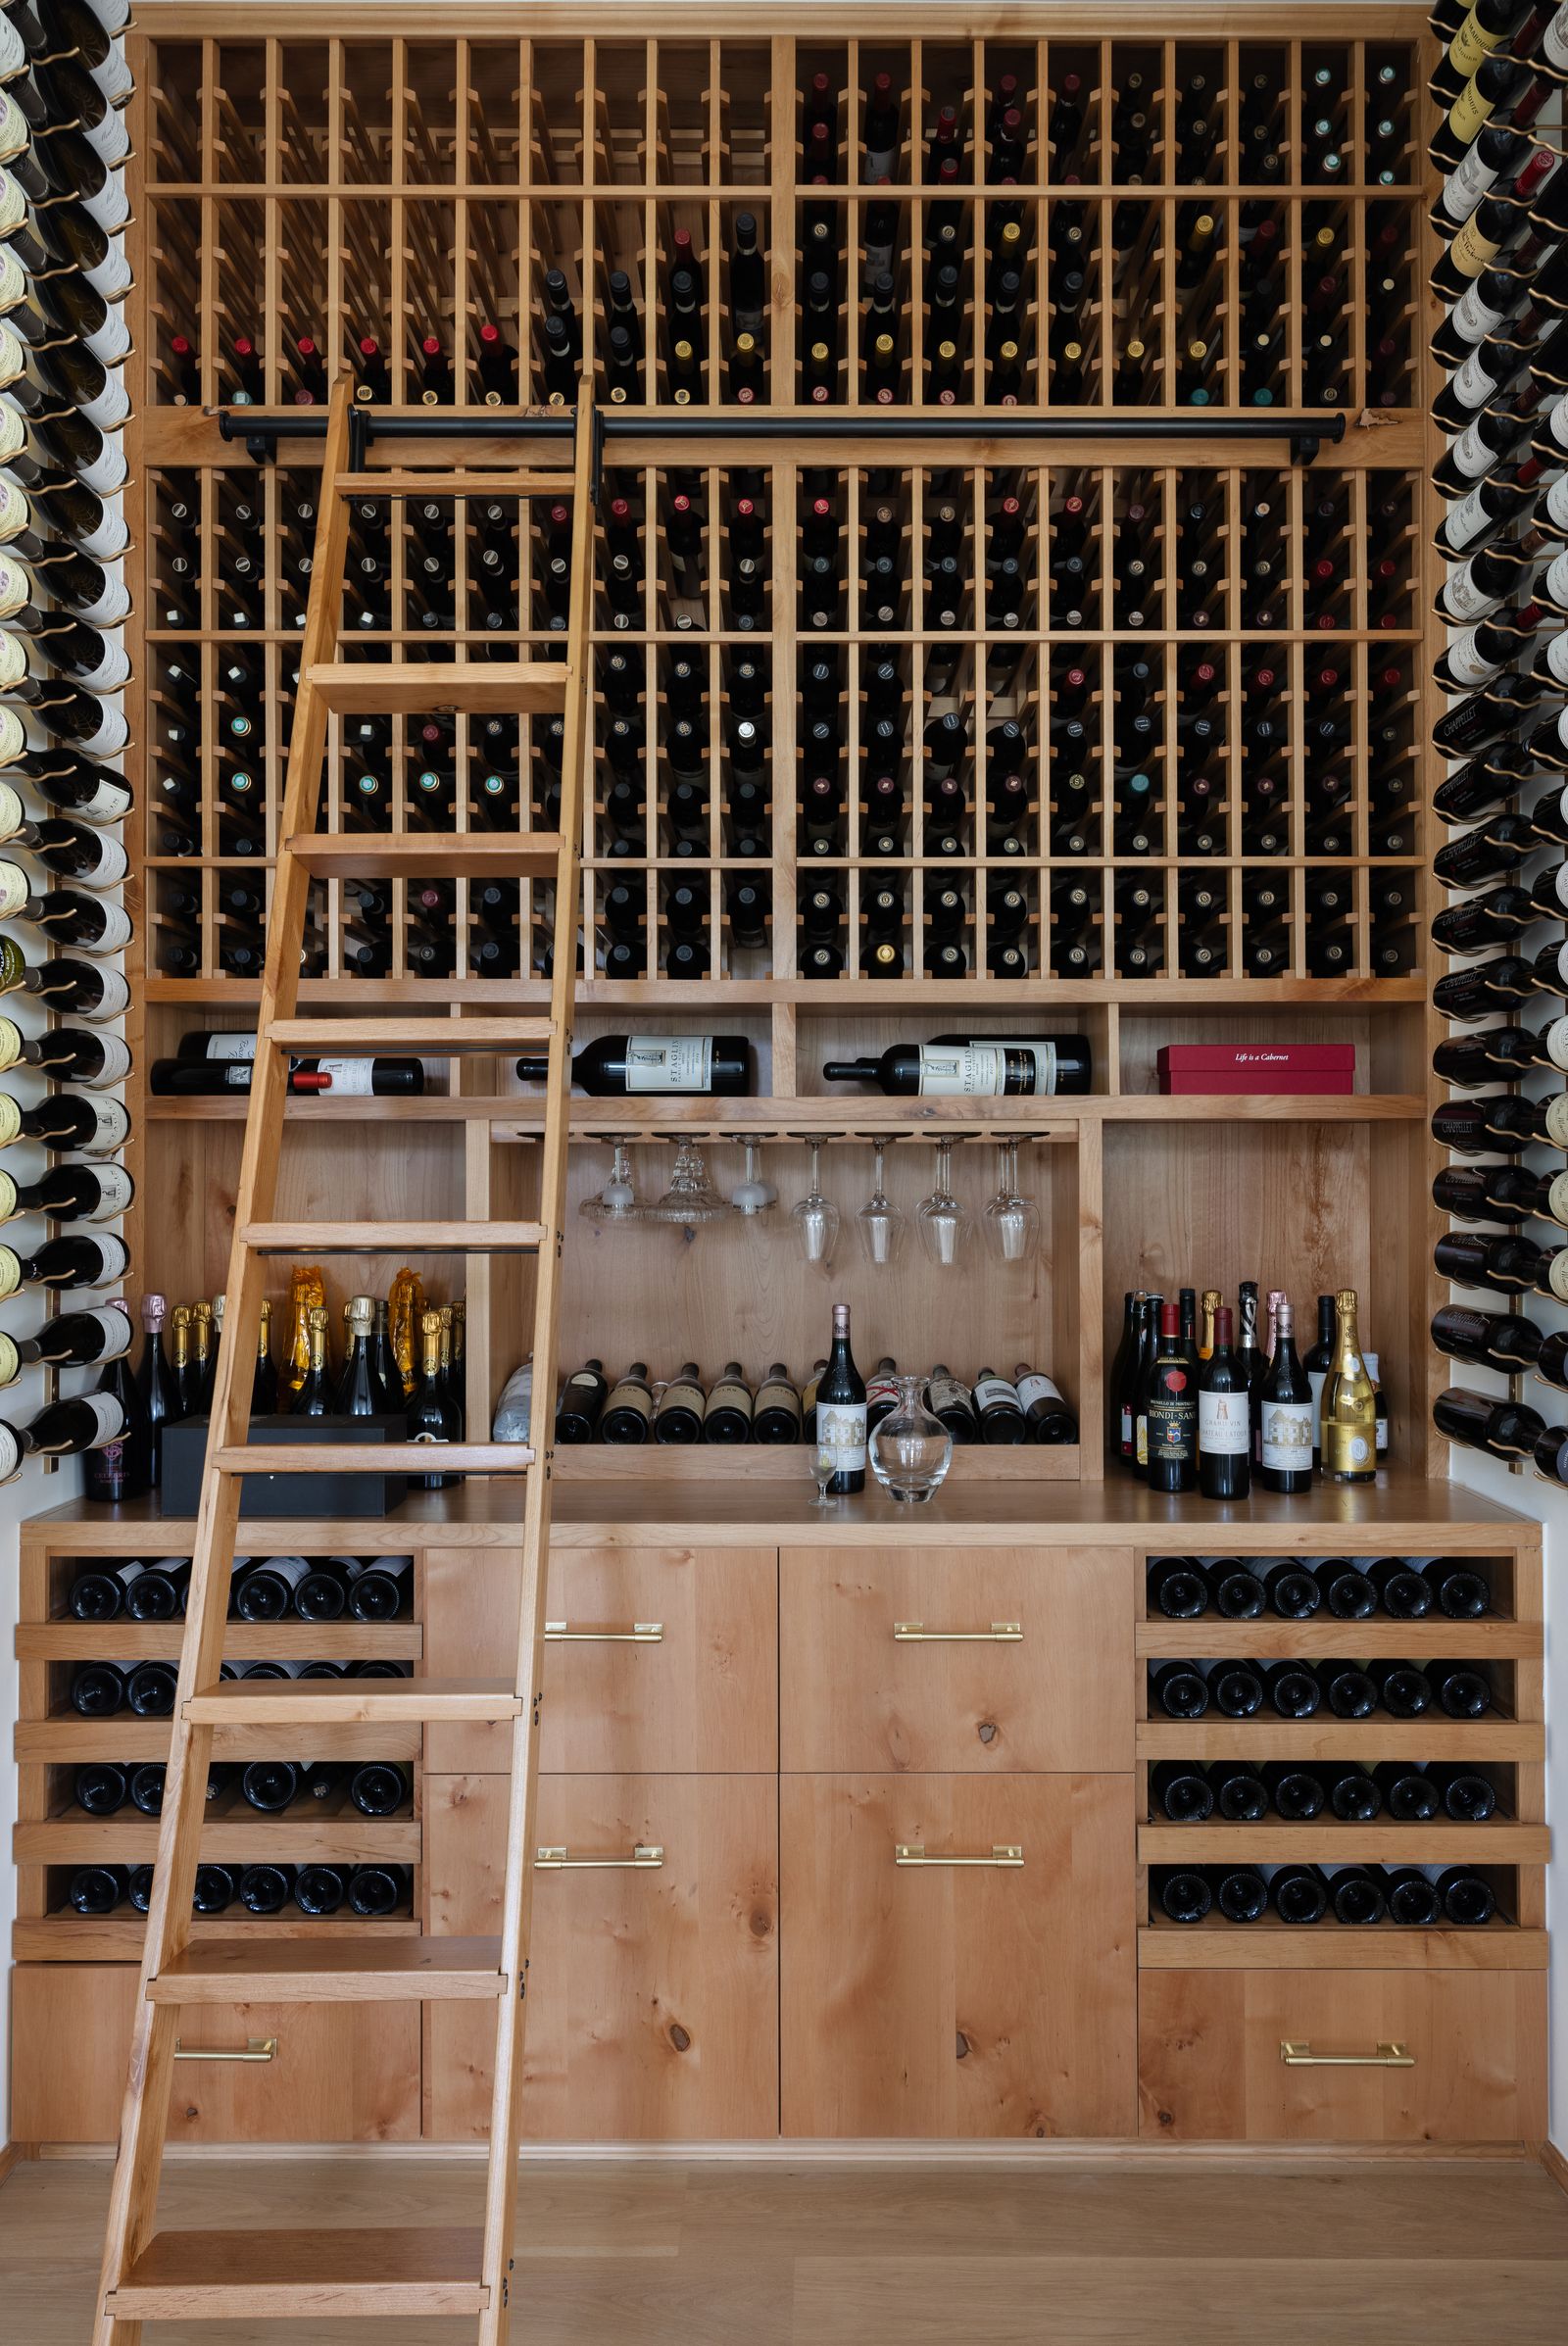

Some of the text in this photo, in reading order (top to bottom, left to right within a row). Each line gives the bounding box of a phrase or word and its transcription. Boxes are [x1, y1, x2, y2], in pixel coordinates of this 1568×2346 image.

[1444, 705, 1477, 736] CHAPPELLET
[1235, 1053, 1248, 1062] Life
[1442, 1121, 1474, 1134] CHAPPELLET
[1149, 1409, 1196, 1420] BIONDI-SANT
